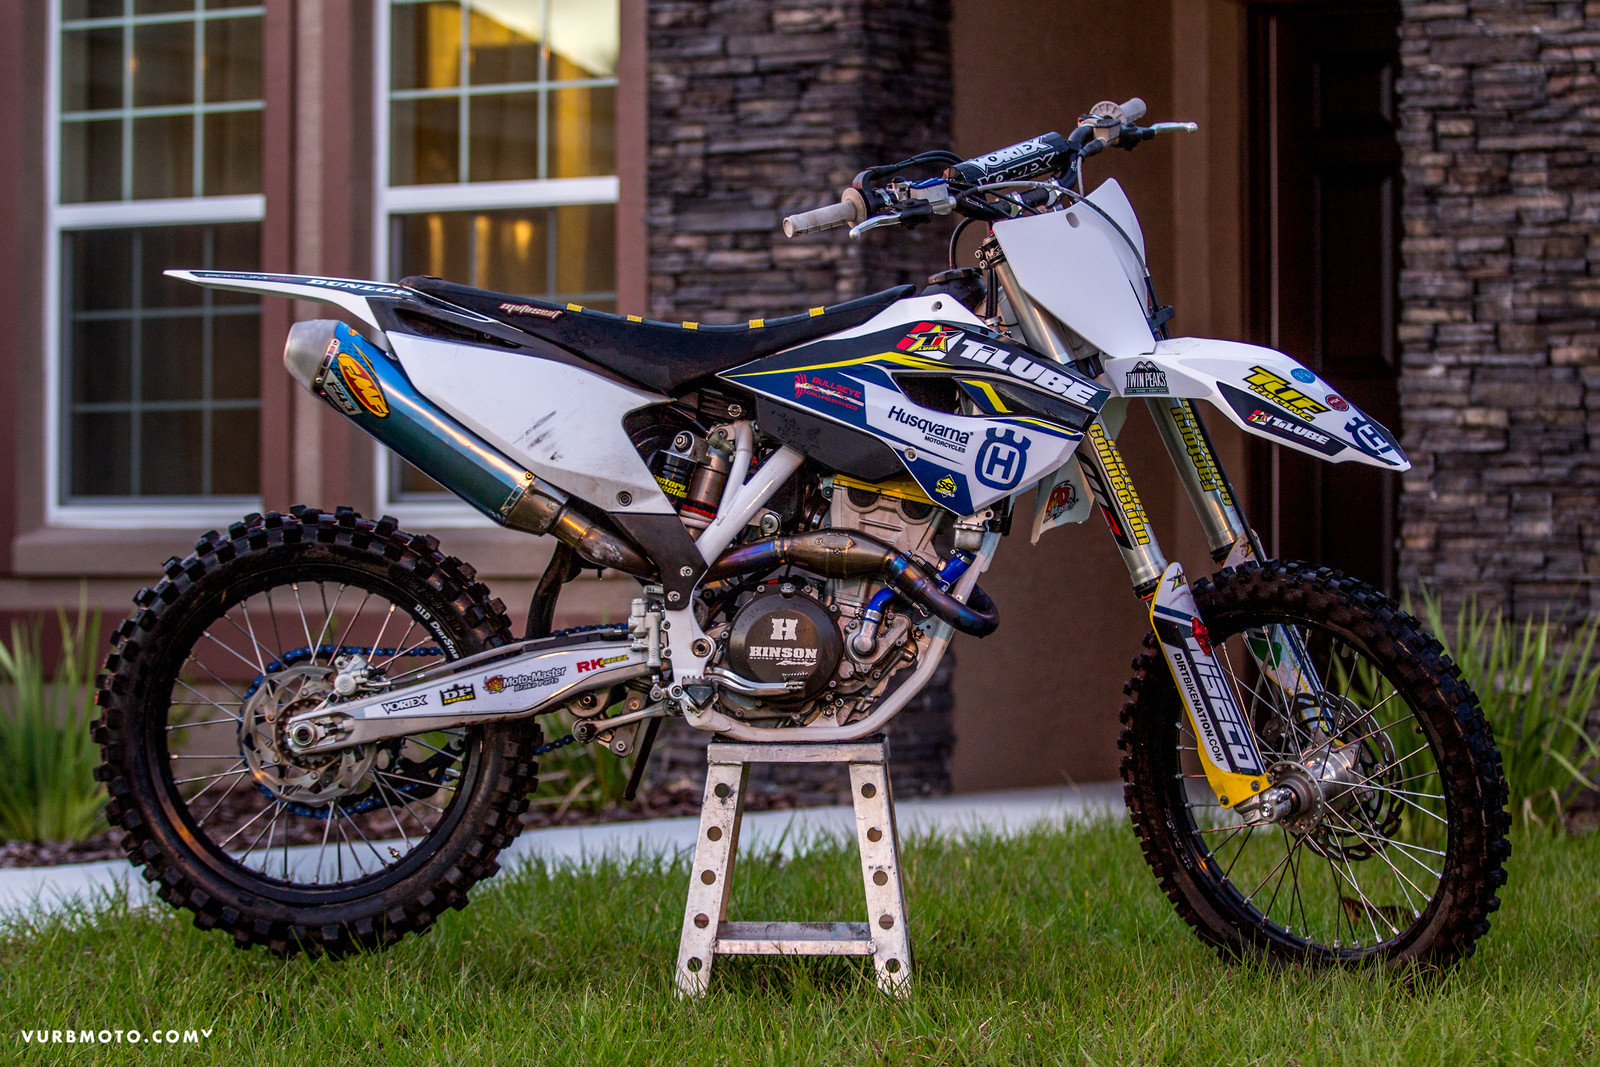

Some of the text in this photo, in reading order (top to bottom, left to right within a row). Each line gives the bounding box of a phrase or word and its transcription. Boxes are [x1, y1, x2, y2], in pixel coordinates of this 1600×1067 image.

[969, 136, 1054, 175] VORTEX
[306, 279, 414, 296] DUNLOP
[337, 355, 390, 414] FMF
[812, 376, 862, 399] BULLSEYE
[1126, 371, 1167, 388] TWIN PEAKS
[1243, 366, 1331, 414] TUF
[806, 390, 858, 411] DRILLING SERVICES
[1248, 385, 1315, 422] RACING
[888, 405, 970, 445] Husqvarna
[924, 435, 966, 453] MOTORCYCLES
[770, 618, 798, 640] H
[749, 646, 818, 659] HINSON
[576, 658, 605, 673] RK
[444, 687, 473, 700] DP
[514, 677, 560, 692] Brake Parts
[381, 694, 428, 714] VORTEX
[1174, 652, 1224, 762] DIRTBIKENATION.COM
